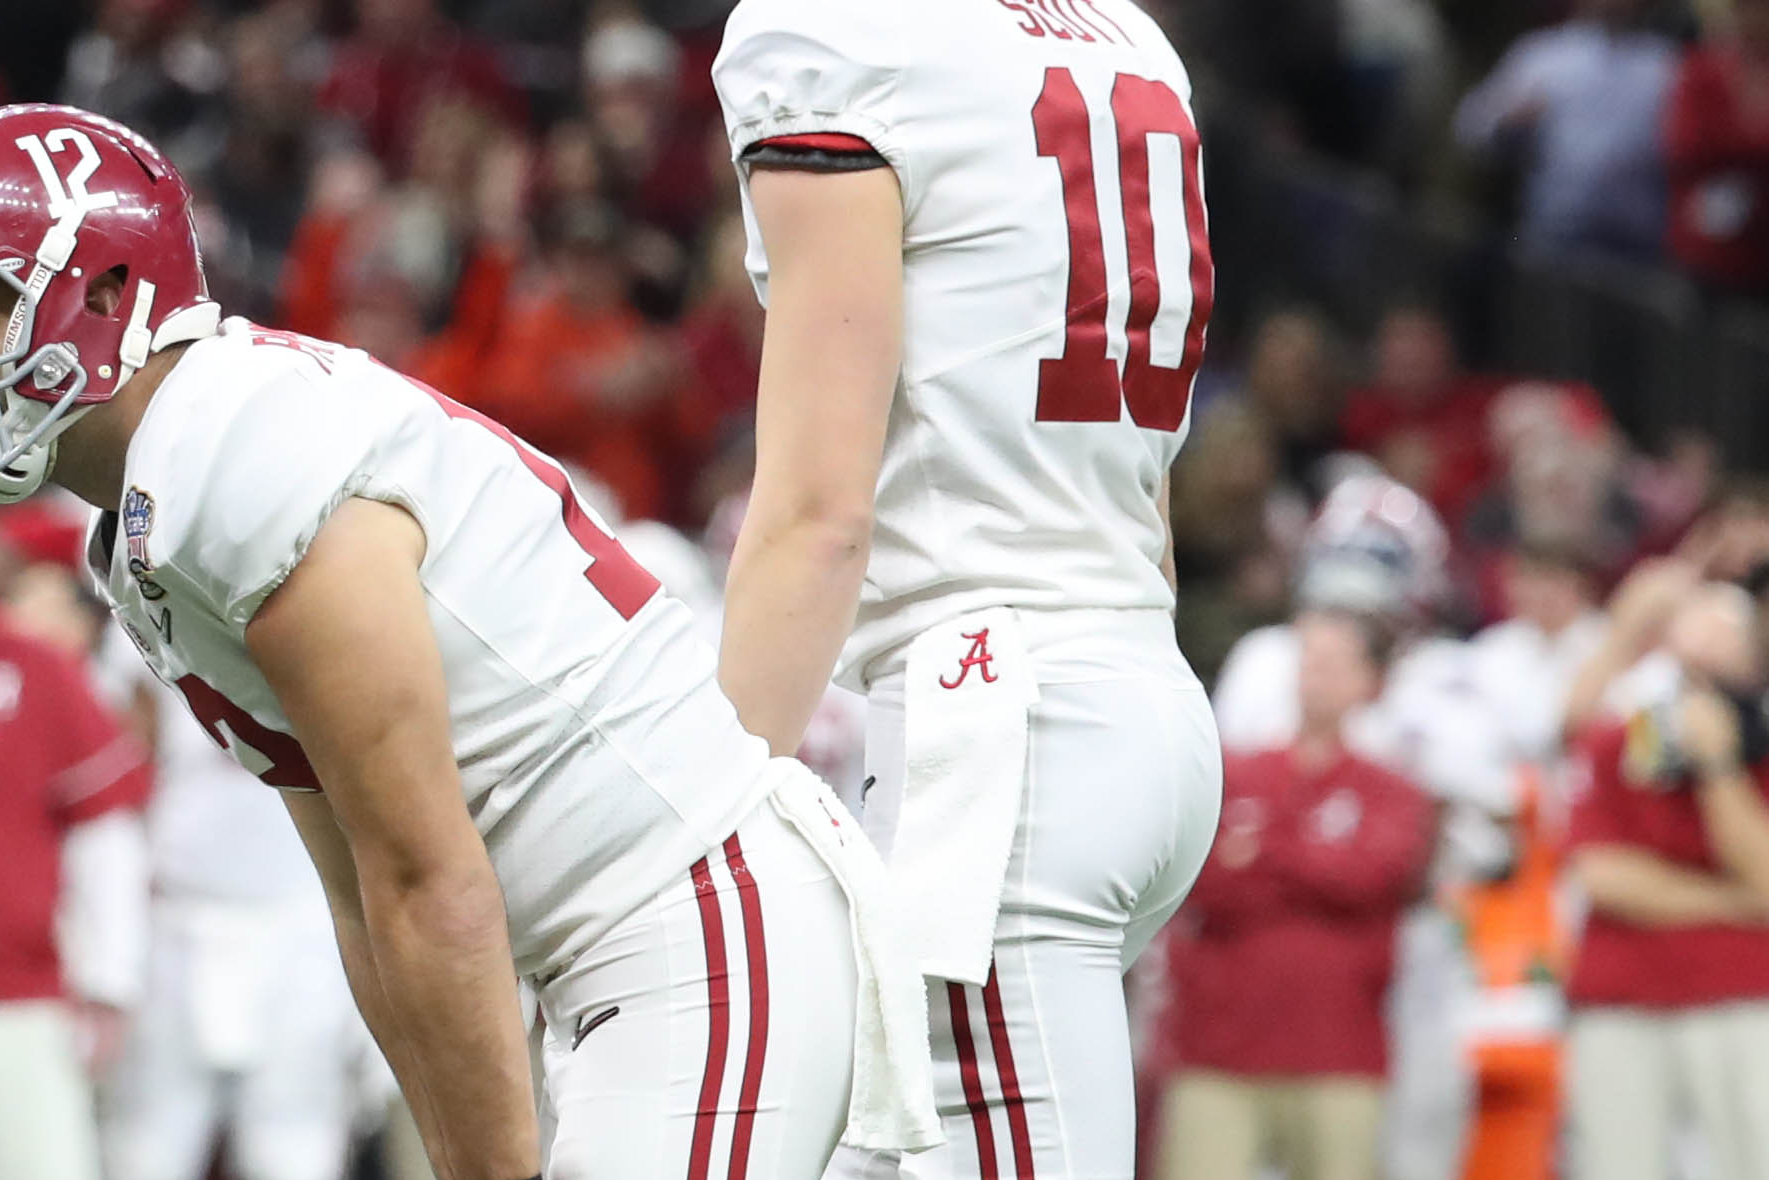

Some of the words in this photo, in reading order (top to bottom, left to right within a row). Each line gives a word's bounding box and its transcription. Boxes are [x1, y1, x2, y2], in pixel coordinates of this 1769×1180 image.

[14, 127, 118, 219] 12
[1031, 66, 1215, 433] 10
[4, 296, 27, 354] CRIMSO
[938, 627, 999, 690] A
